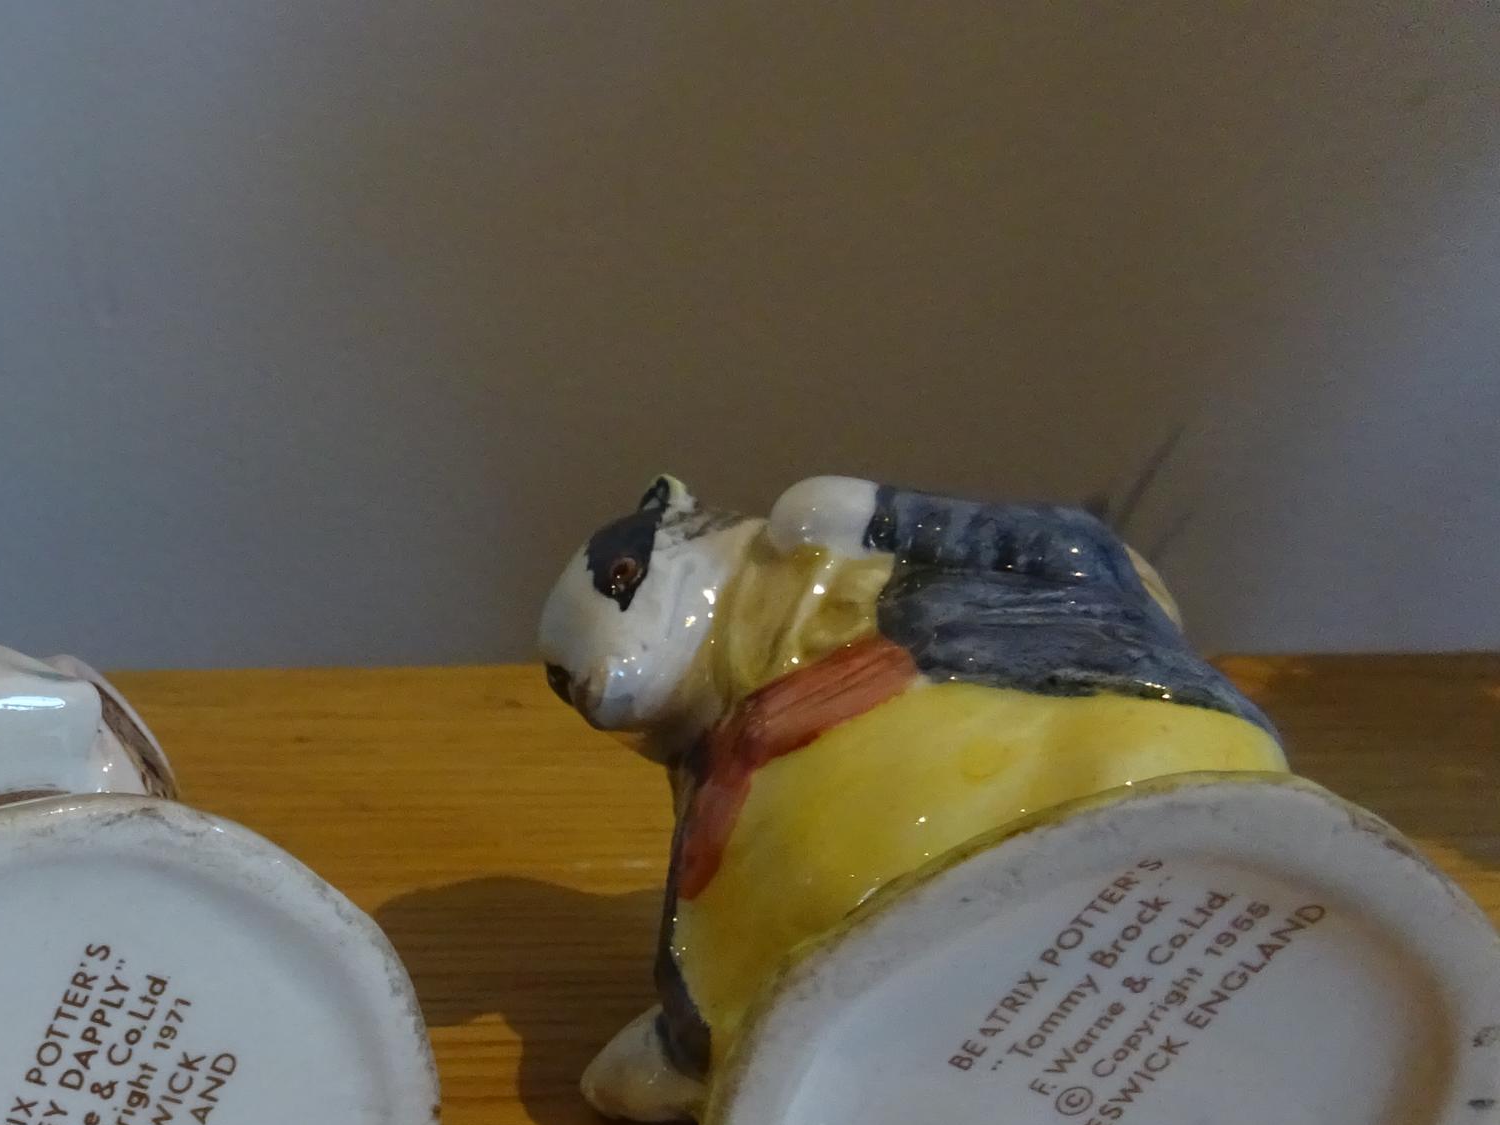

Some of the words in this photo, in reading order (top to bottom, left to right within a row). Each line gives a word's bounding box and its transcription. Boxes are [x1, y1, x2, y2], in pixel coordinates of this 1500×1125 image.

[25, 942, 111, 1086] POTTER'S
[948, 971, 1049, 1072] BEATRIX
[1038, 858, 1164, 968] POTTER'S
[1121, 976, 1155, 995] &
[1183, 903, 1328, 1030] ENGLAND
[153, 997, 192, 1051] 1971
[1091, 966, 1204, 1079] Copyright
[90, 1080, 117, 1101] &
